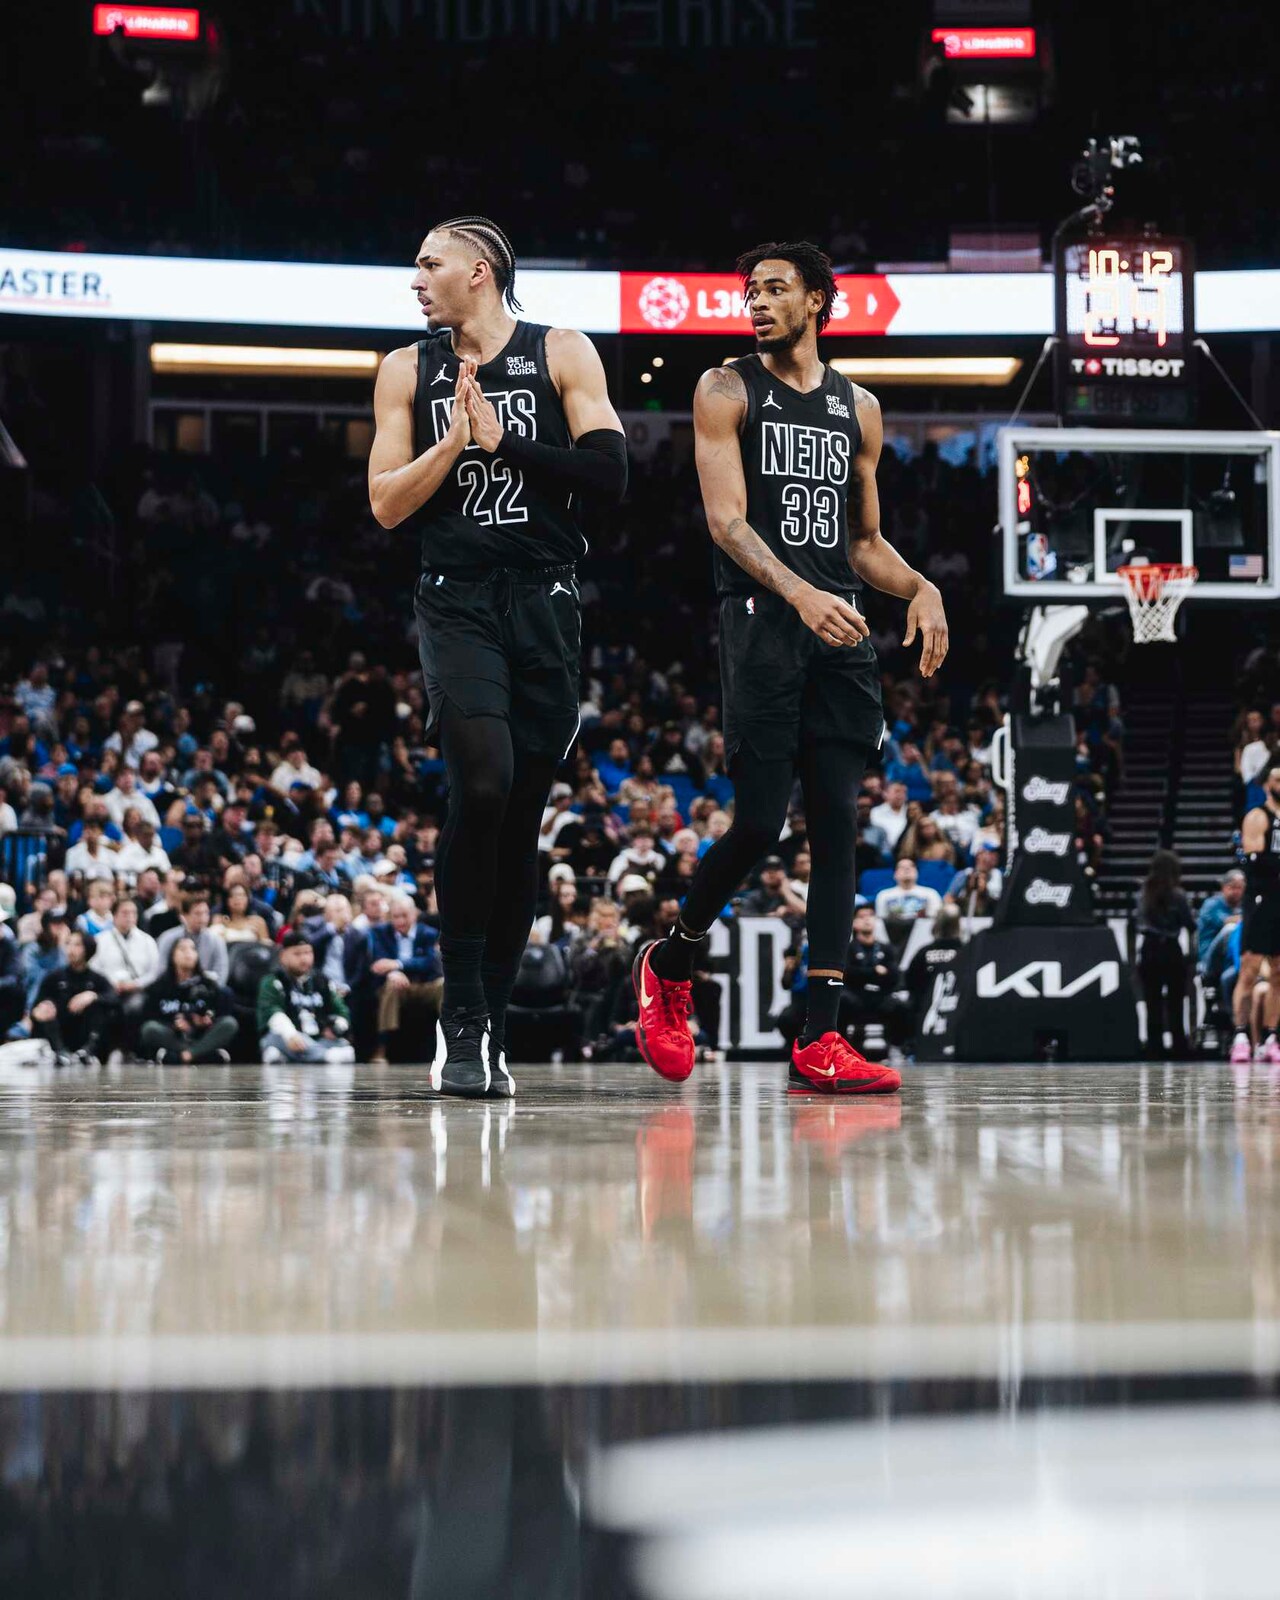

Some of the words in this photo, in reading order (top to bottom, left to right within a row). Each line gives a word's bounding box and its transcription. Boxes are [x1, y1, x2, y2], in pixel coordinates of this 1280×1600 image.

[507, 361, 535, 369] YOUR
[507, 367, 538, 375] GUIDE
[1102, 358, 1185, 378] TISSOT
[826, 394, 840, 403] GET
[827, 400, 848, 411] YOUR
[431, 389, 537, 451] NTS
[828, 407, 850, 419] GUIDE
[761, 421, 850, 485] NETS
[457, 457, 528, 527] 22
[780, 483, 839, 548] 33
